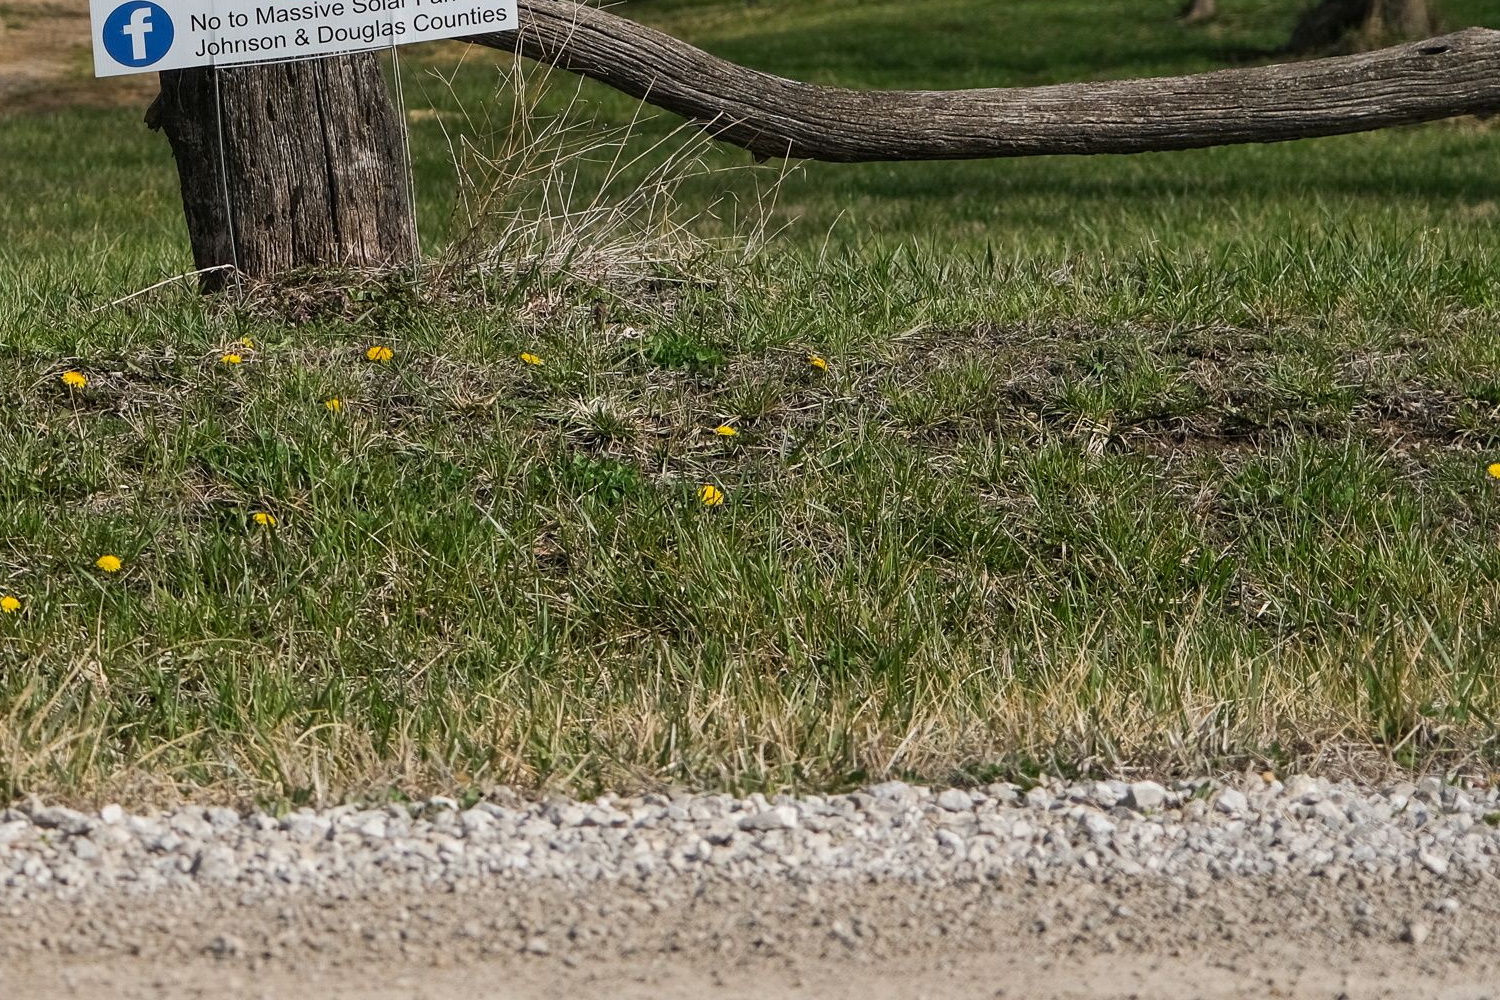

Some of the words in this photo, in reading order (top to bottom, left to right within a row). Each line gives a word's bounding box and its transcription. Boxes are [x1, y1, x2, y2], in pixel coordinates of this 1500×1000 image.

[190, 13, 221, 32] No
[228, 11, 249, 28] to
[256, 1, 345, 25] Massive
[195, 34, 287, 57] Johnson
[294, 28, 310, 47] &
[317, 19, 406, 44] Douglas
[413, 6, 508, 31] Counties
